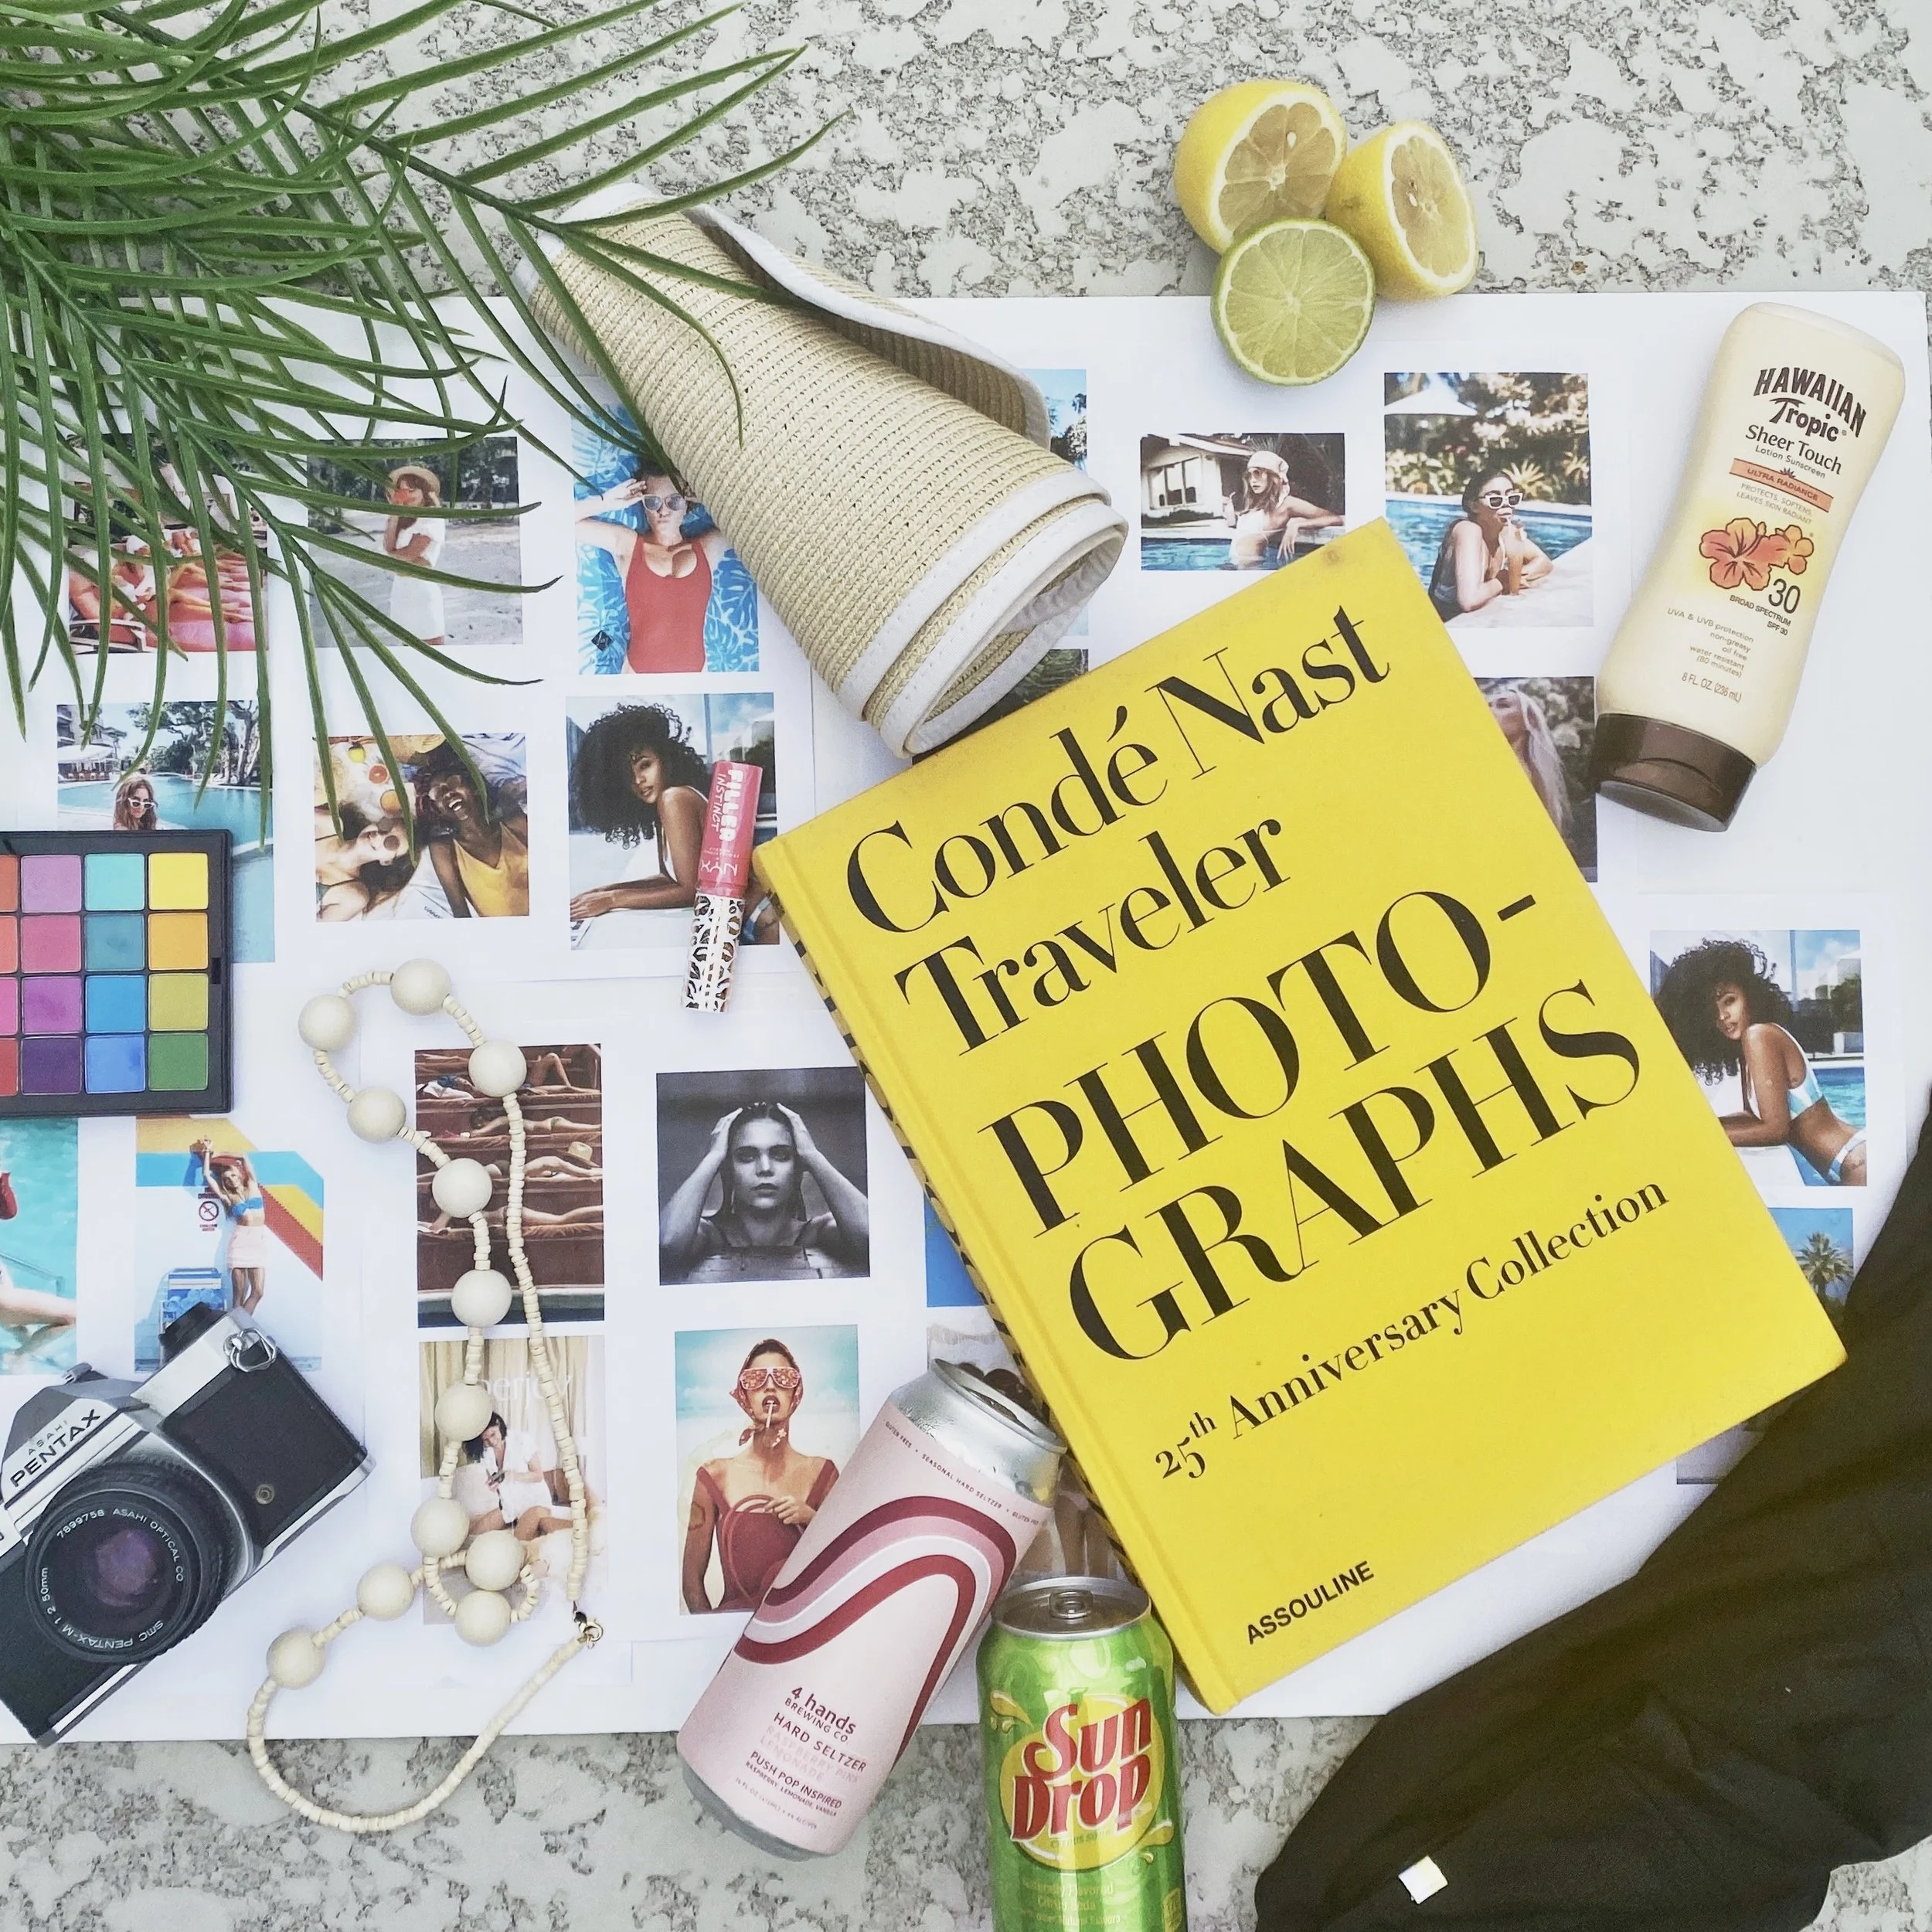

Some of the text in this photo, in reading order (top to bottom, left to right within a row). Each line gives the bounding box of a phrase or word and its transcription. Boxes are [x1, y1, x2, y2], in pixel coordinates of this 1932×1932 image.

[1753, 367, 1866, 437] HAWAIIAN
[1770, 397, 1838, 443] Tropic
[1746, 424, 1842, 474] Sheer Touch
[1756, 445, 1826, 479] Lotion Sunscreen
[1736, 492, 1812, 525] LEAVES SKIN RADIANT
[1747, 468, 1819, 501] ULTRA RADIANCE
[1730, 594, 1791, 627] BROAD SPECTRUM
[1768, 578, 1801, 614] 30
[1667, 607, 1685, 618] UVA
[1696, 616, 1714, 627] UVB
[1715, 623, 1754, 643] protection
[1709, 631, 1751, 653] non-greasy
[1767, 621, 1788, 636] SPF 30
[1682, 672, 1687, 682] 8
[1689, 645, 1745, 671] water resistant
[1711, 661, 1743, 679] minutes)
[1722, 646, 1747, 661] oil free
[845, 604, 1389, 934] Condé Nast
[711, 773, 727, 833] INSTINCT
[719, 768, 744, 842] FILLER
[896, 816, 1291, 1056] Traveler
[978, 889, 1536, 1240] PHOTO-
[1068, 979, 1641, 1362] GRAPHS
[1229, 1288, 1464, 1440] Anniversary
[1466, 1182, 1669, 1301] Collection
[10, 1409, 100, 1488] PENTAX
[27, 1420, 68, 1455] ASAHI
[922, 1454, 954, 1480] SEASONAL
[956, 1477, 975, 1493] HARD
[976, 1491, 1002, 1509] SELTZER
[56, 1509, 184, 1582] 7899758 ASAHI OPTICAL CO
[40, 1567, 51, 1602] 50mm
[1247, 1561, 1375, 1645] ASSOULINE
[62, 1624, 134, 1649] PENTAX-M
[785, 1698, 832, 1734] BREWING
[791, 1687, 856, 1735] 4 hands
[774, 1712, 867, 1773] HARD SELTZER
[1024, 1698, 1151, 1778] Sun
[750, 1750, 777, 1774] PUSH
[777, 1771, 800, 1788] POP
[801, 1784, 842, 1809] INSPIRED
[1012, 1753, 1151, 1842] Drop
